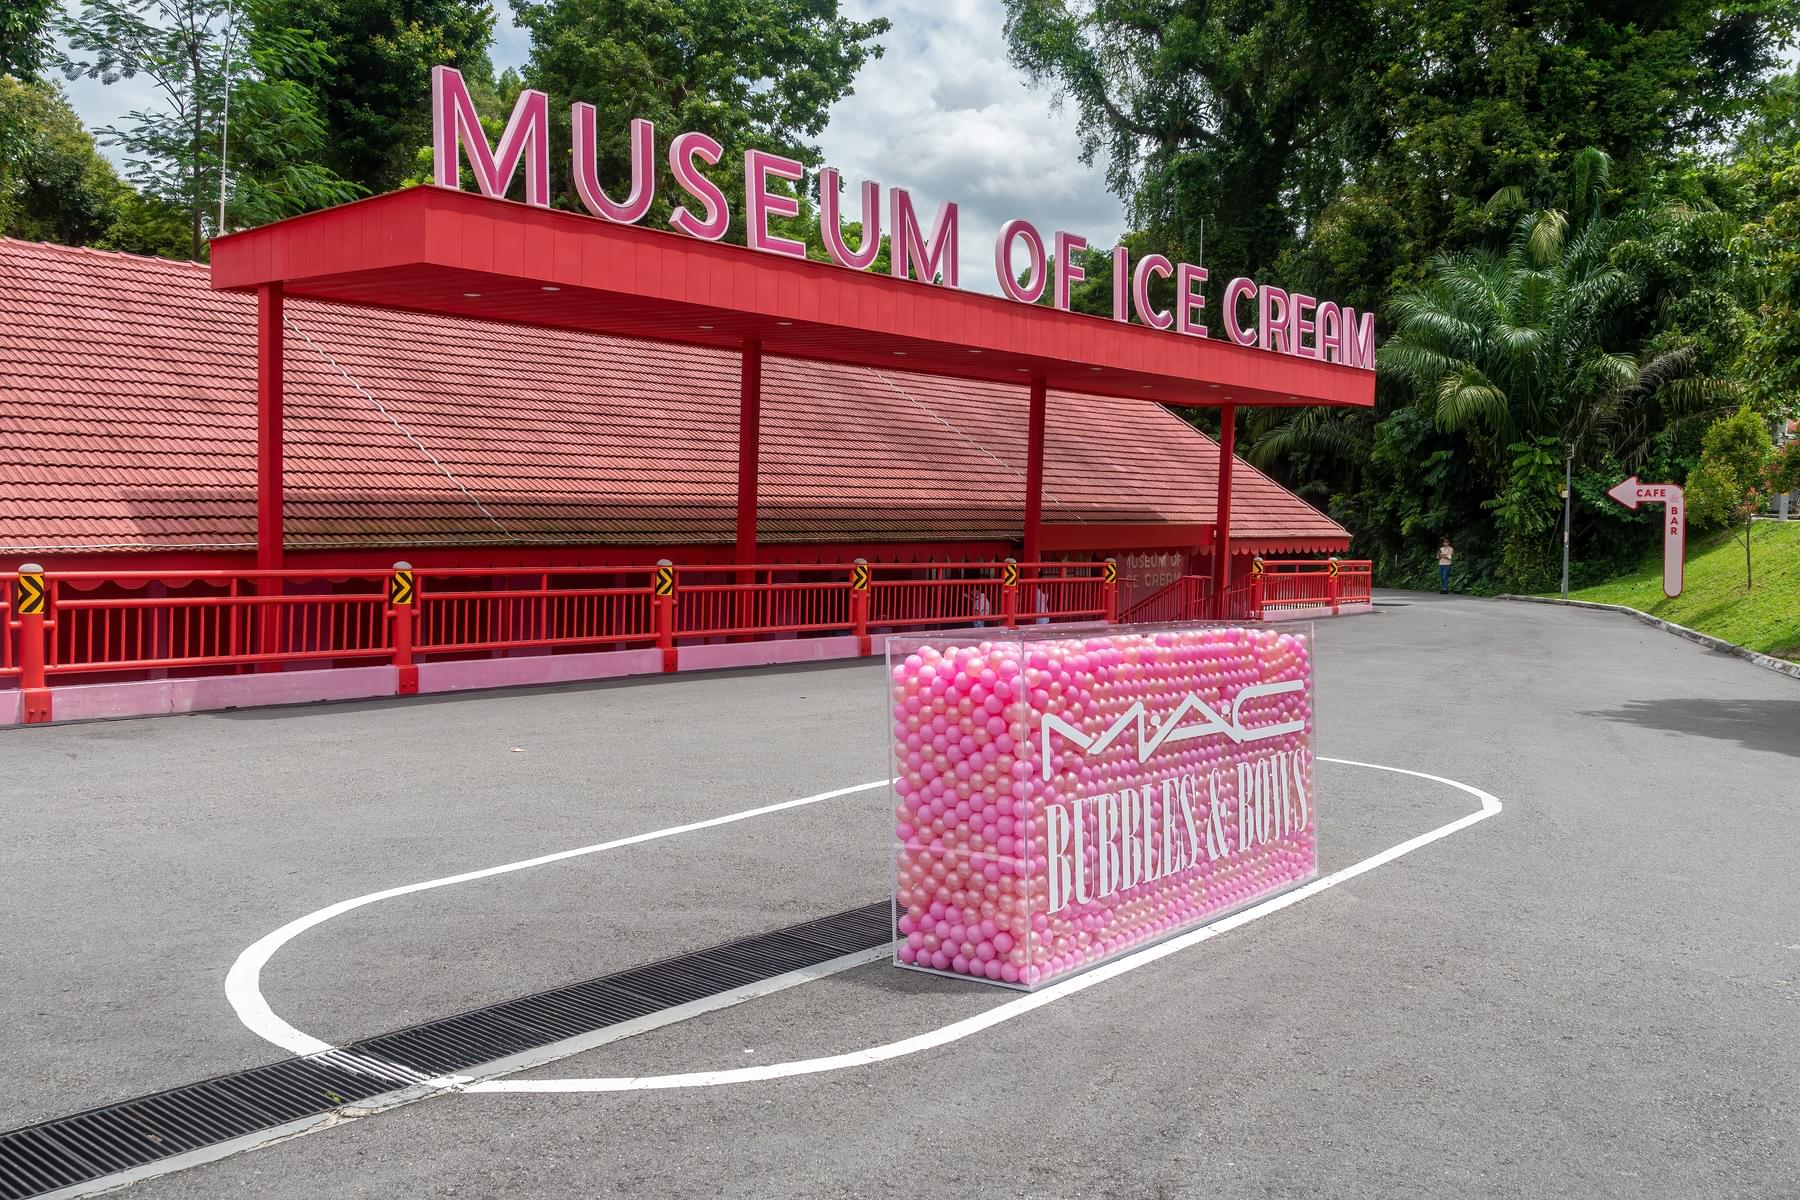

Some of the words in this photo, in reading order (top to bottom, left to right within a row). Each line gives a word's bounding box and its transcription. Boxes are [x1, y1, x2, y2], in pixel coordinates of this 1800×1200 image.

[432, 64, 960, 288] MUSEUM
[995, 219, 1088, 311] OF
[1113, 246, 1209, 338] ICE
[1223, 277, 1375, 370] CREAM
[1636, 488, 1666, 497] CAFE
[1670, 507, 1678, 535] BAR
[1044, 773, 1199, 916] BUBBLES
[1206, 768, 1230, 862] &
[1236, 748, 1308, 853] BOWS
